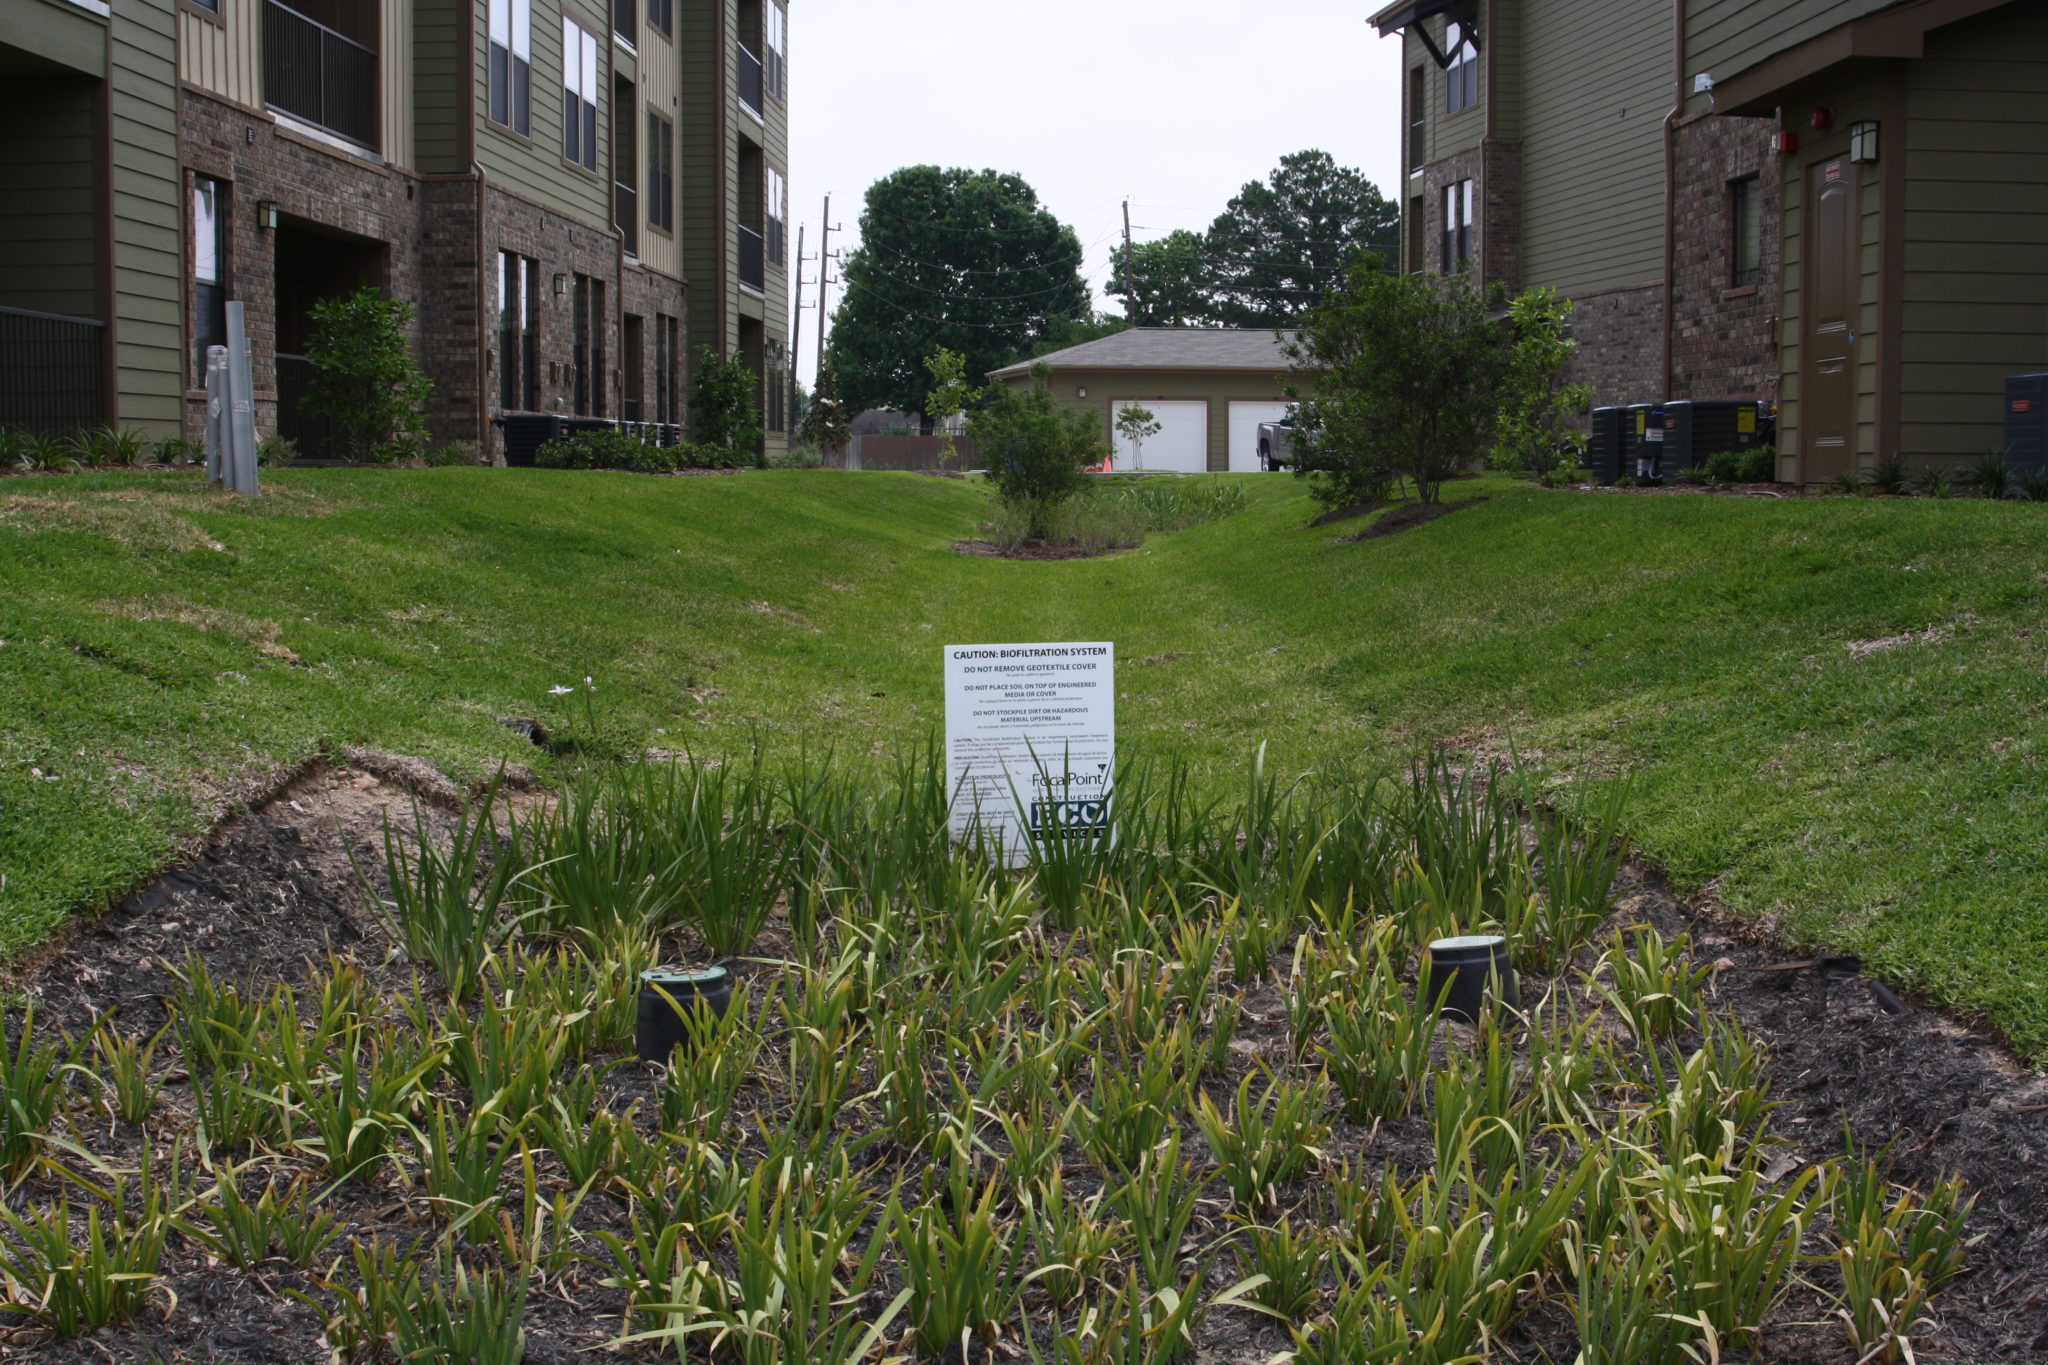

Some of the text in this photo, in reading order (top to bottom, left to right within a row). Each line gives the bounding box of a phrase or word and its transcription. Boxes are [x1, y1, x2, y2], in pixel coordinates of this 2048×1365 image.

[954, 648, 1106, 659] CAUTION: BIOFILTRATION SYSTEM
